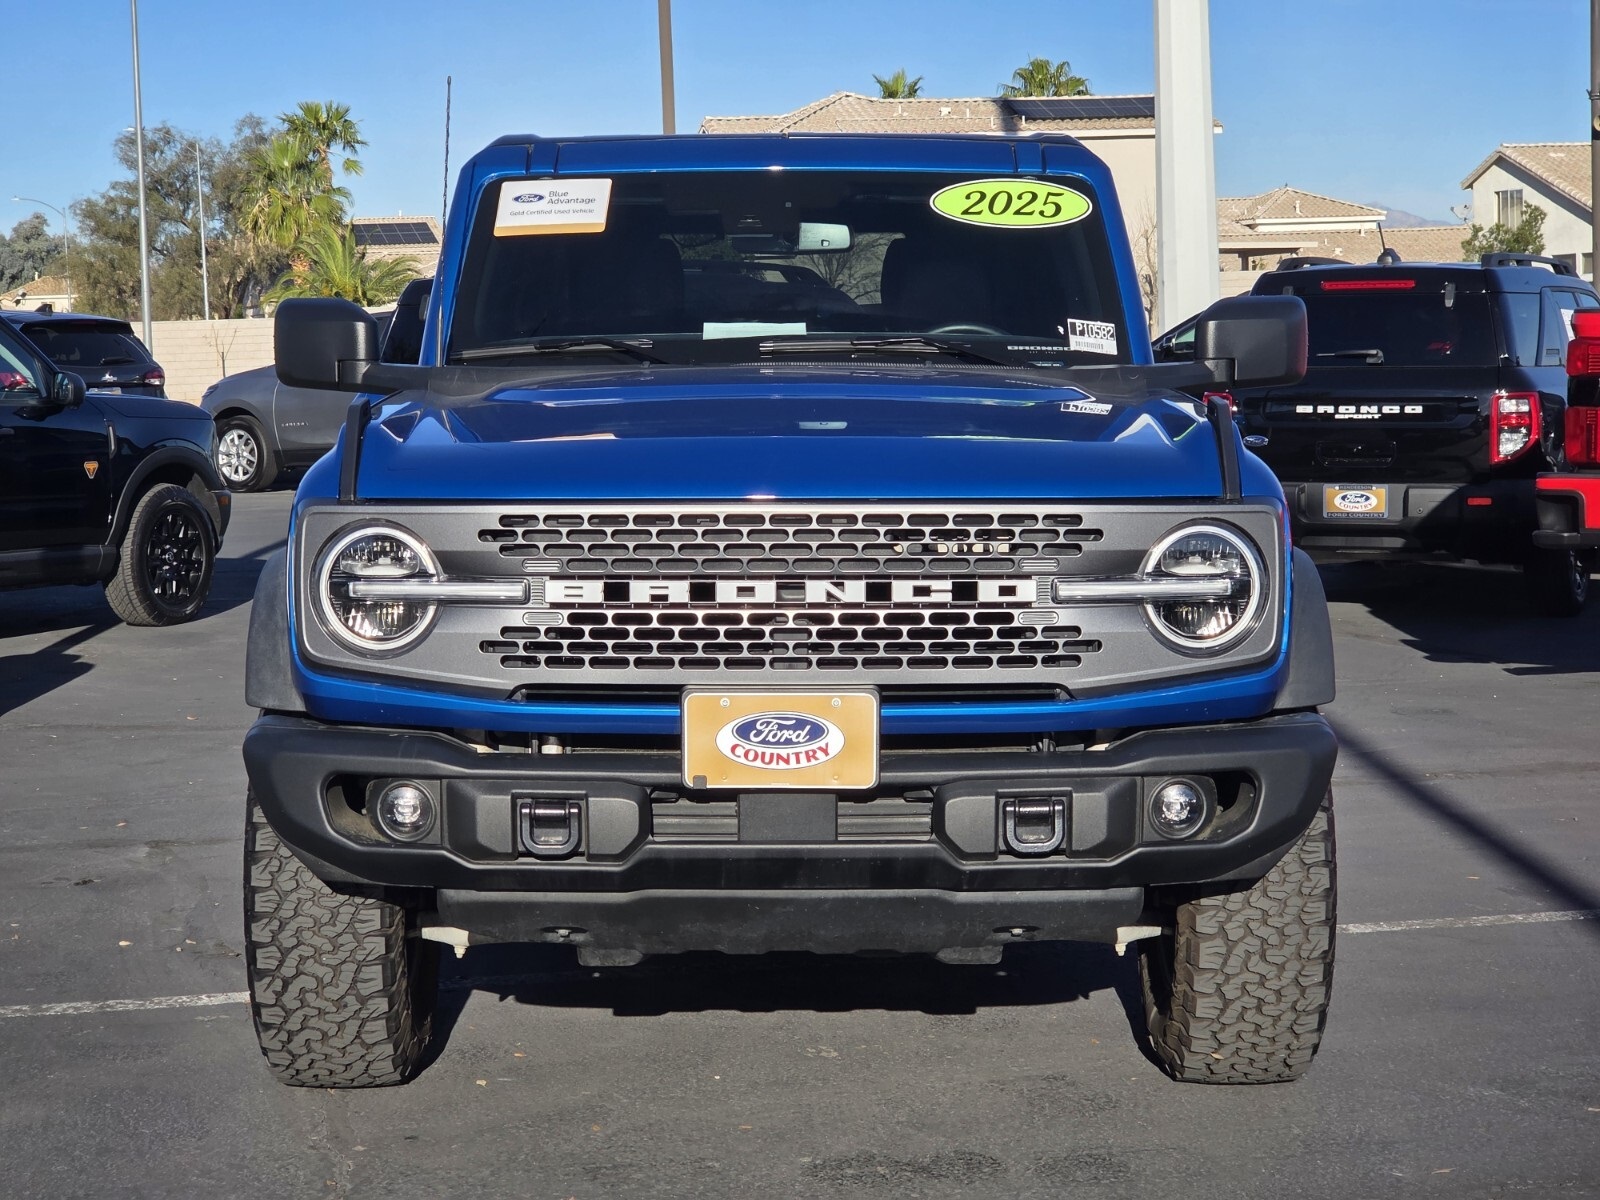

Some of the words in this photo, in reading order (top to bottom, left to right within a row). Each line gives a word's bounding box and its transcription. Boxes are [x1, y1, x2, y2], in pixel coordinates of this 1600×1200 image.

[546, 197, 596, 205] Advantage
[548, 190, 569, 198] Blue
[960, 190, 1065, 218] 2025
[1075, 322, 1115, 341] P10582
[1295, 404, 1424, 414] BRONCO
[1345, 493, 1367, 503] Ford
[1339, 502, 1373, 510] COUNTRY
[544, 578, 1037, 603] BRONCO
[749, 718, 811, 743] Ford
[730, 742, 832, 766] COUNTRY
